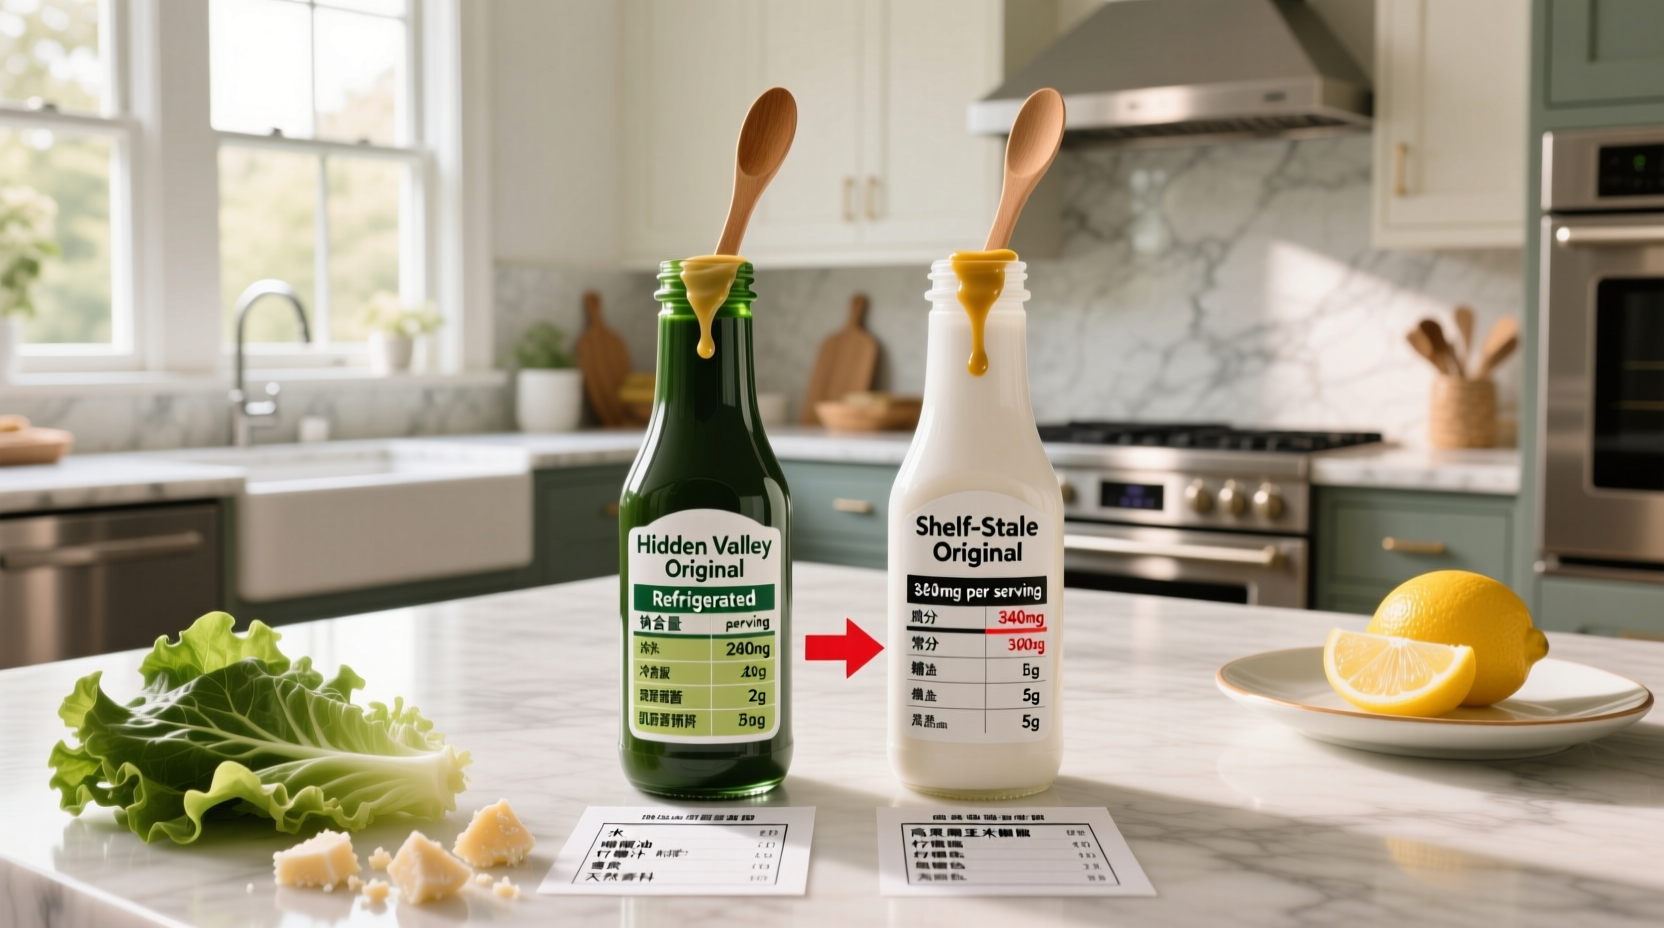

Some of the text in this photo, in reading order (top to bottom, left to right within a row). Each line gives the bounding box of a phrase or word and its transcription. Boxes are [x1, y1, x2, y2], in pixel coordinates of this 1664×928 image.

[915, 515, 1039, 537] Shelf-Stale
[637, 534, 772, 560] Hidden Valley
[932, 541, 1023, 568] Original
[665, 558, 744, 582] Original
[652, 589, 756, 613] Refrigerated
[966, 586, 990, 602] per
[993, 583, 1042, 600] serving
[998, 610, 1045, 629] 340mg
[748, 689, 766, 705] 2g
[1022, 688, 1040, 705] 5g
[1022, 714, 1040, 731] 5g
